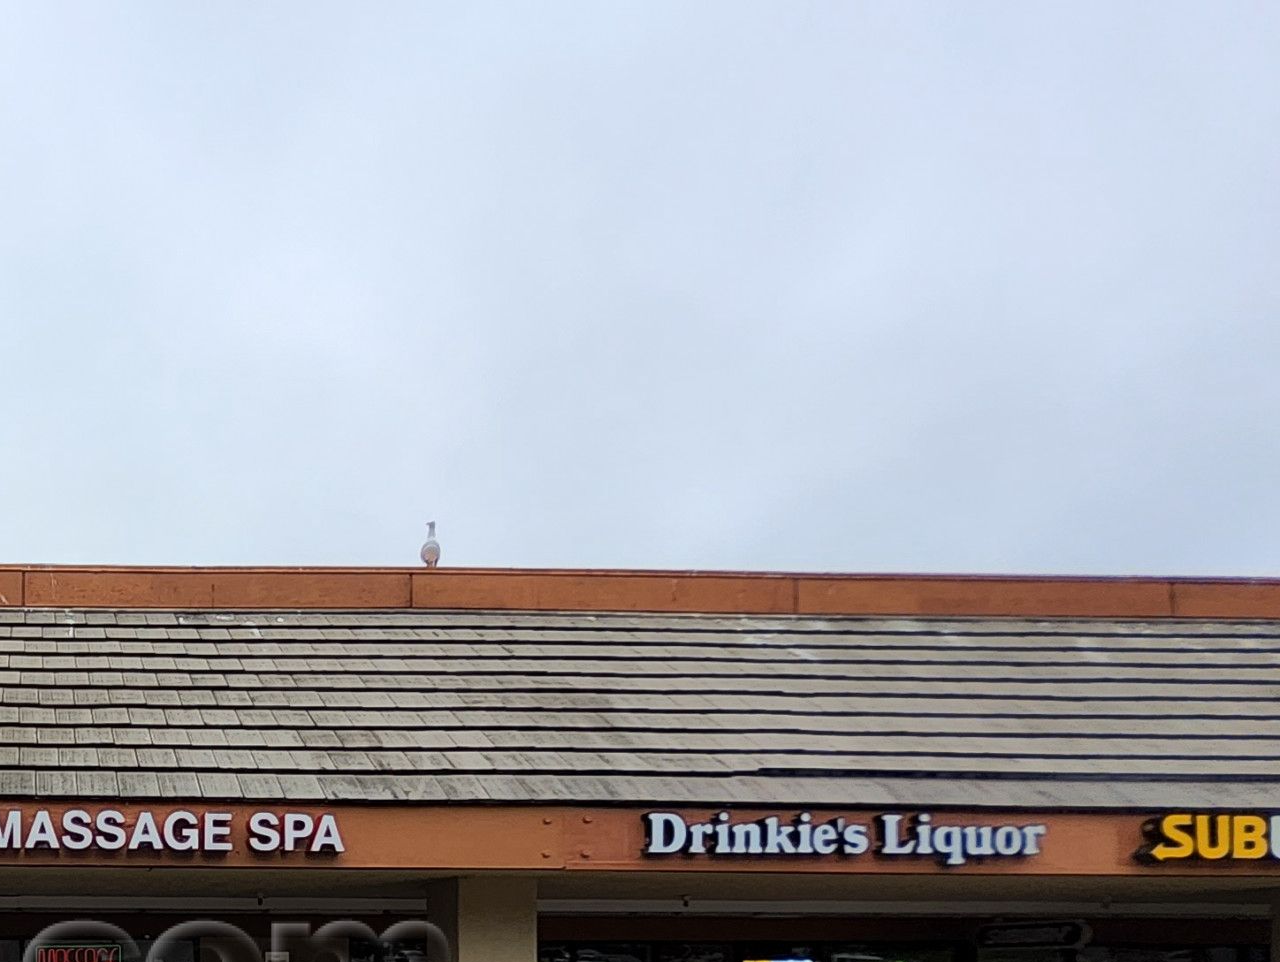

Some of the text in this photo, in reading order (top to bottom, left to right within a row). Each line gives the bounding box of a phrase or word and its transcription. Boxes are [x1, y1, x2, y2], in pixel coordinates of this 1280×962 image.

[249, 812, 345, 852] SPA
[648, 812, 1047, 864] Drinkie's Liquor
[1151, 814, 1280, 860] SUB
